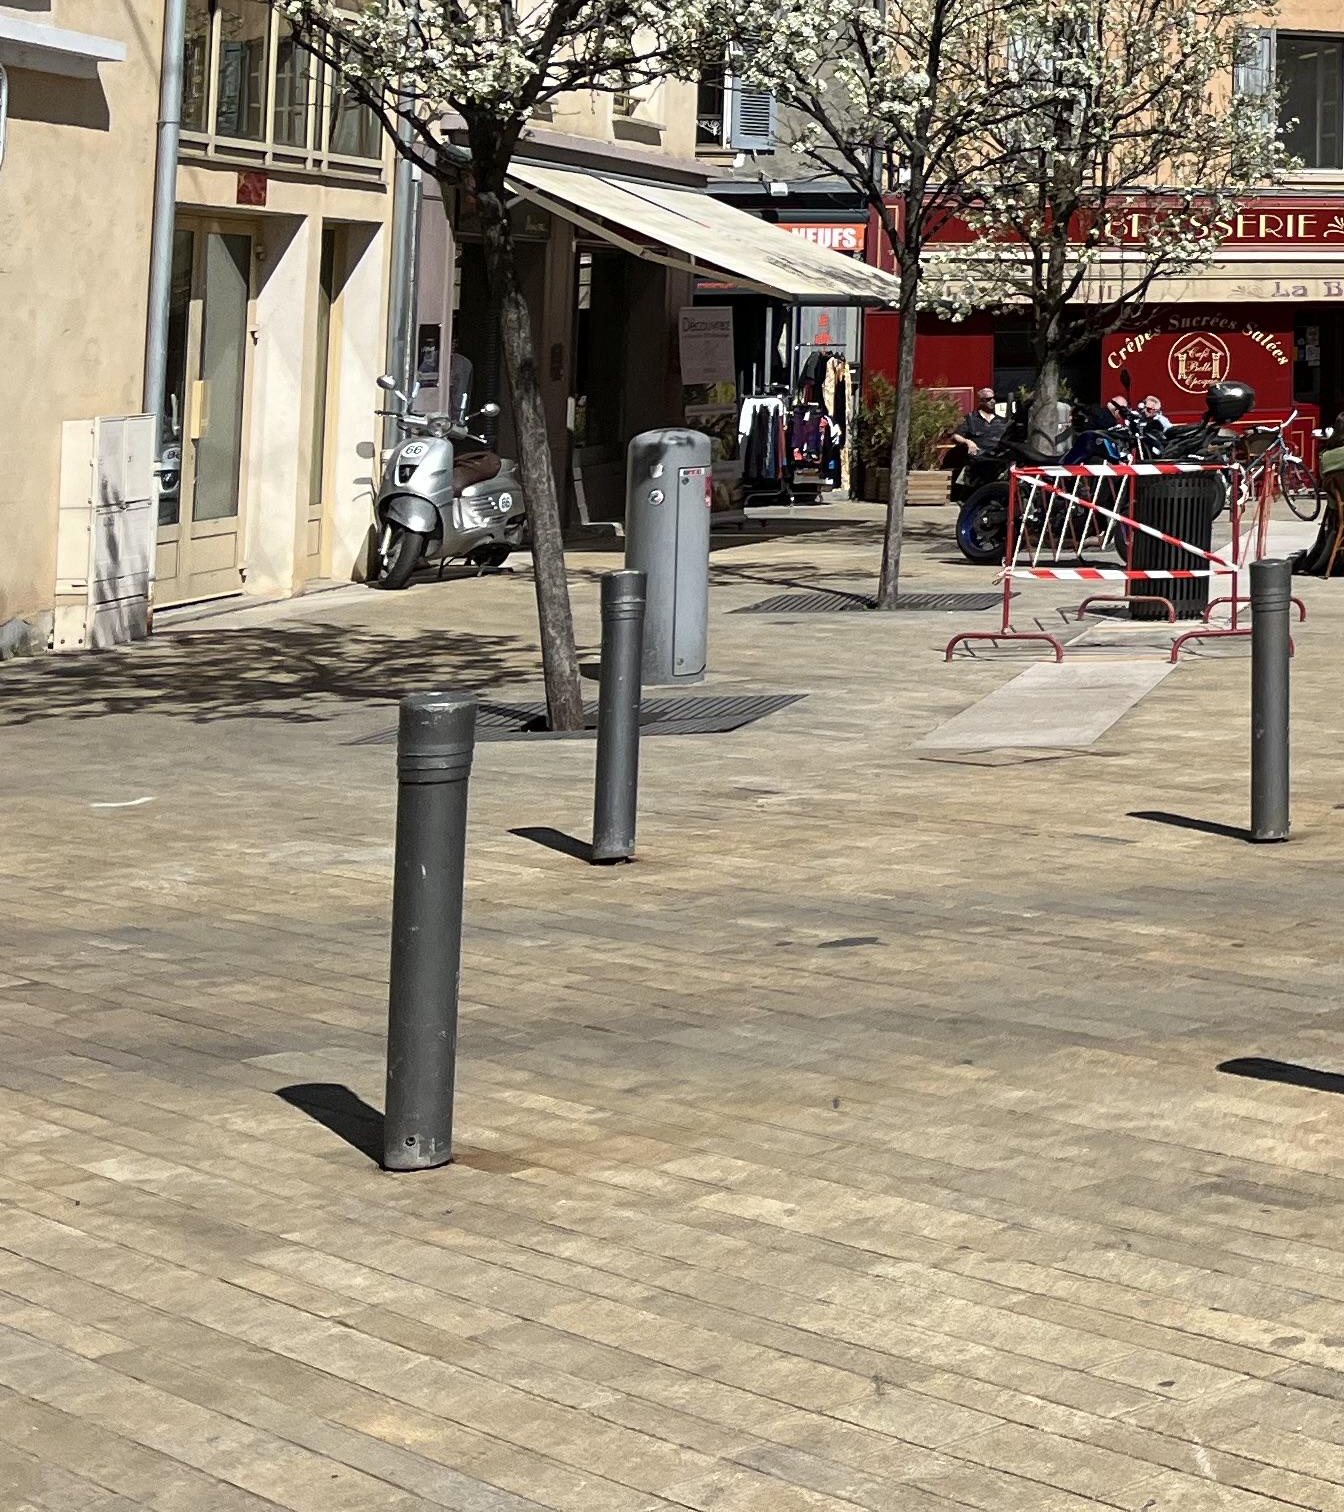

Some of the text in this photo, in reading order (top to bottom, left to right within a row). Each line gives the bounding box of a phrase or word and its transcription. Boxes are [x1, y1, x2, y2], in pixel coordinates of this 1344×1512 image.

[1105, 213, 1317, 239] BRSSERIE
[1271, 281, 1308, 298] La
[1168, 312, 1238, 331] Sucrées
[1242, 322, 1290, 367] Salées
